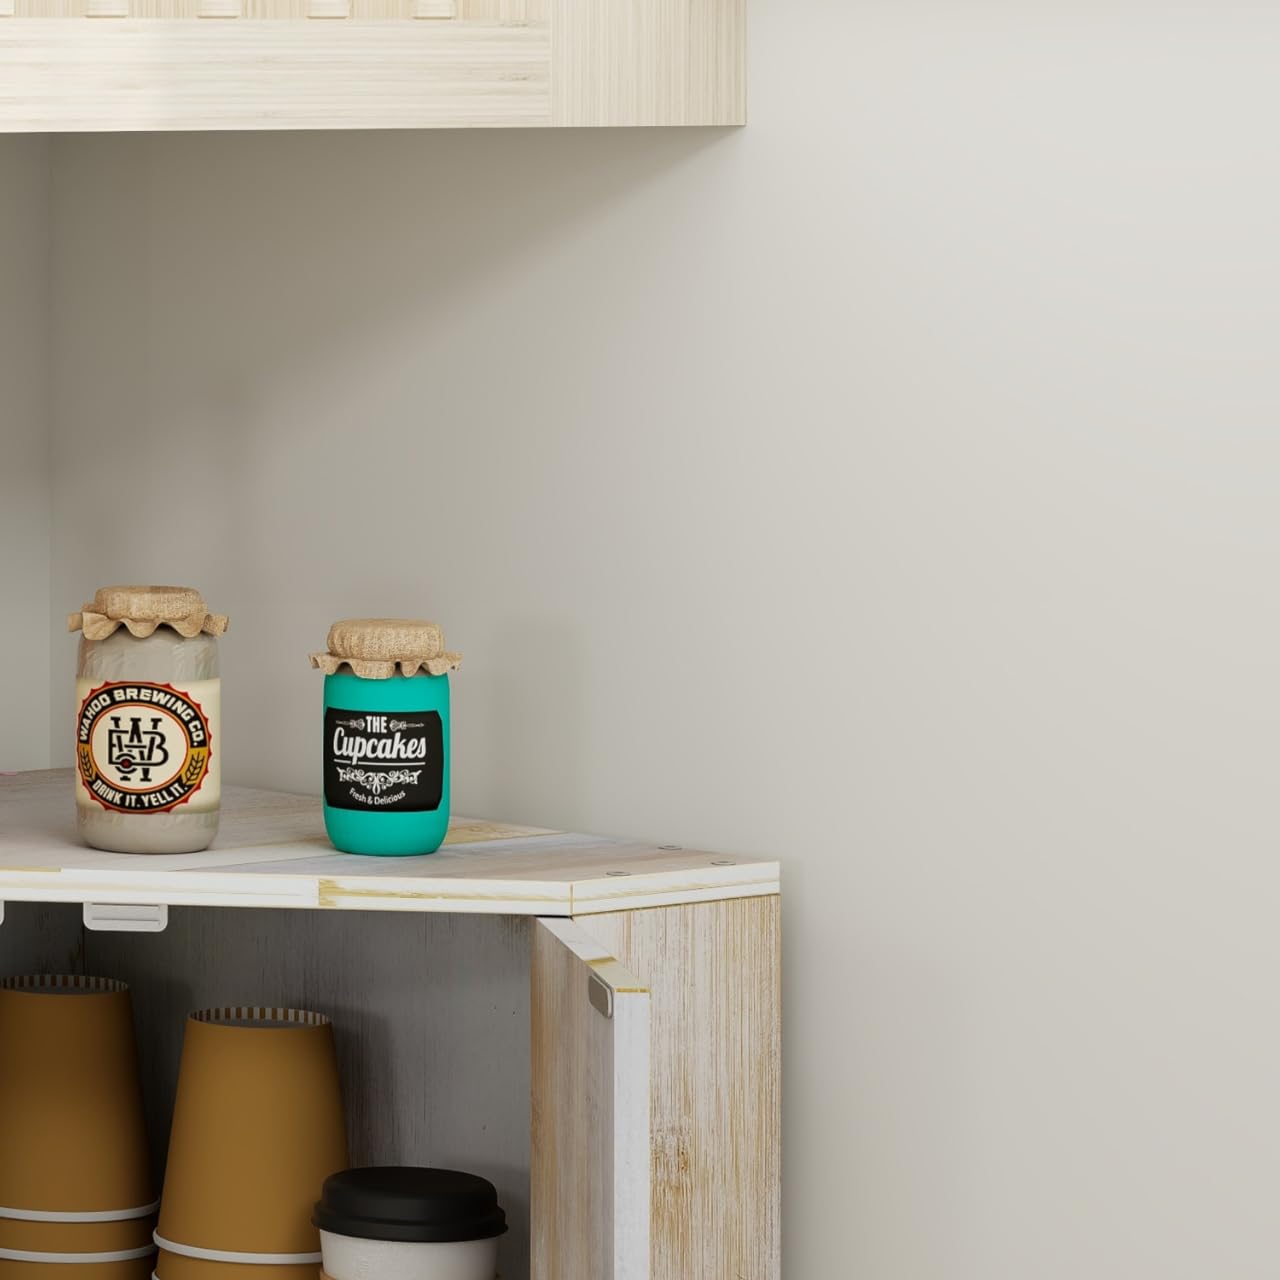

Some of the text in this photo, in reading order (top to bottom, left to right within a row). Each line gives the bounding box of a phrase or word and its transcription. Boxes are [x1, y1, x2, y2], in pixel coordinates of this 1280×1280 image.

[113, 688, 195, 722] BREWING
[366, 716, 388, 733] THE
[333, 727, 426, 765] Cupcakes
[92, 779, 122, 805] DRINK
[124, 794, 141, 808] IT.
[141, 790, 171, 807] YELL
[349, 787, 406, 805] Fresh & Delicious
